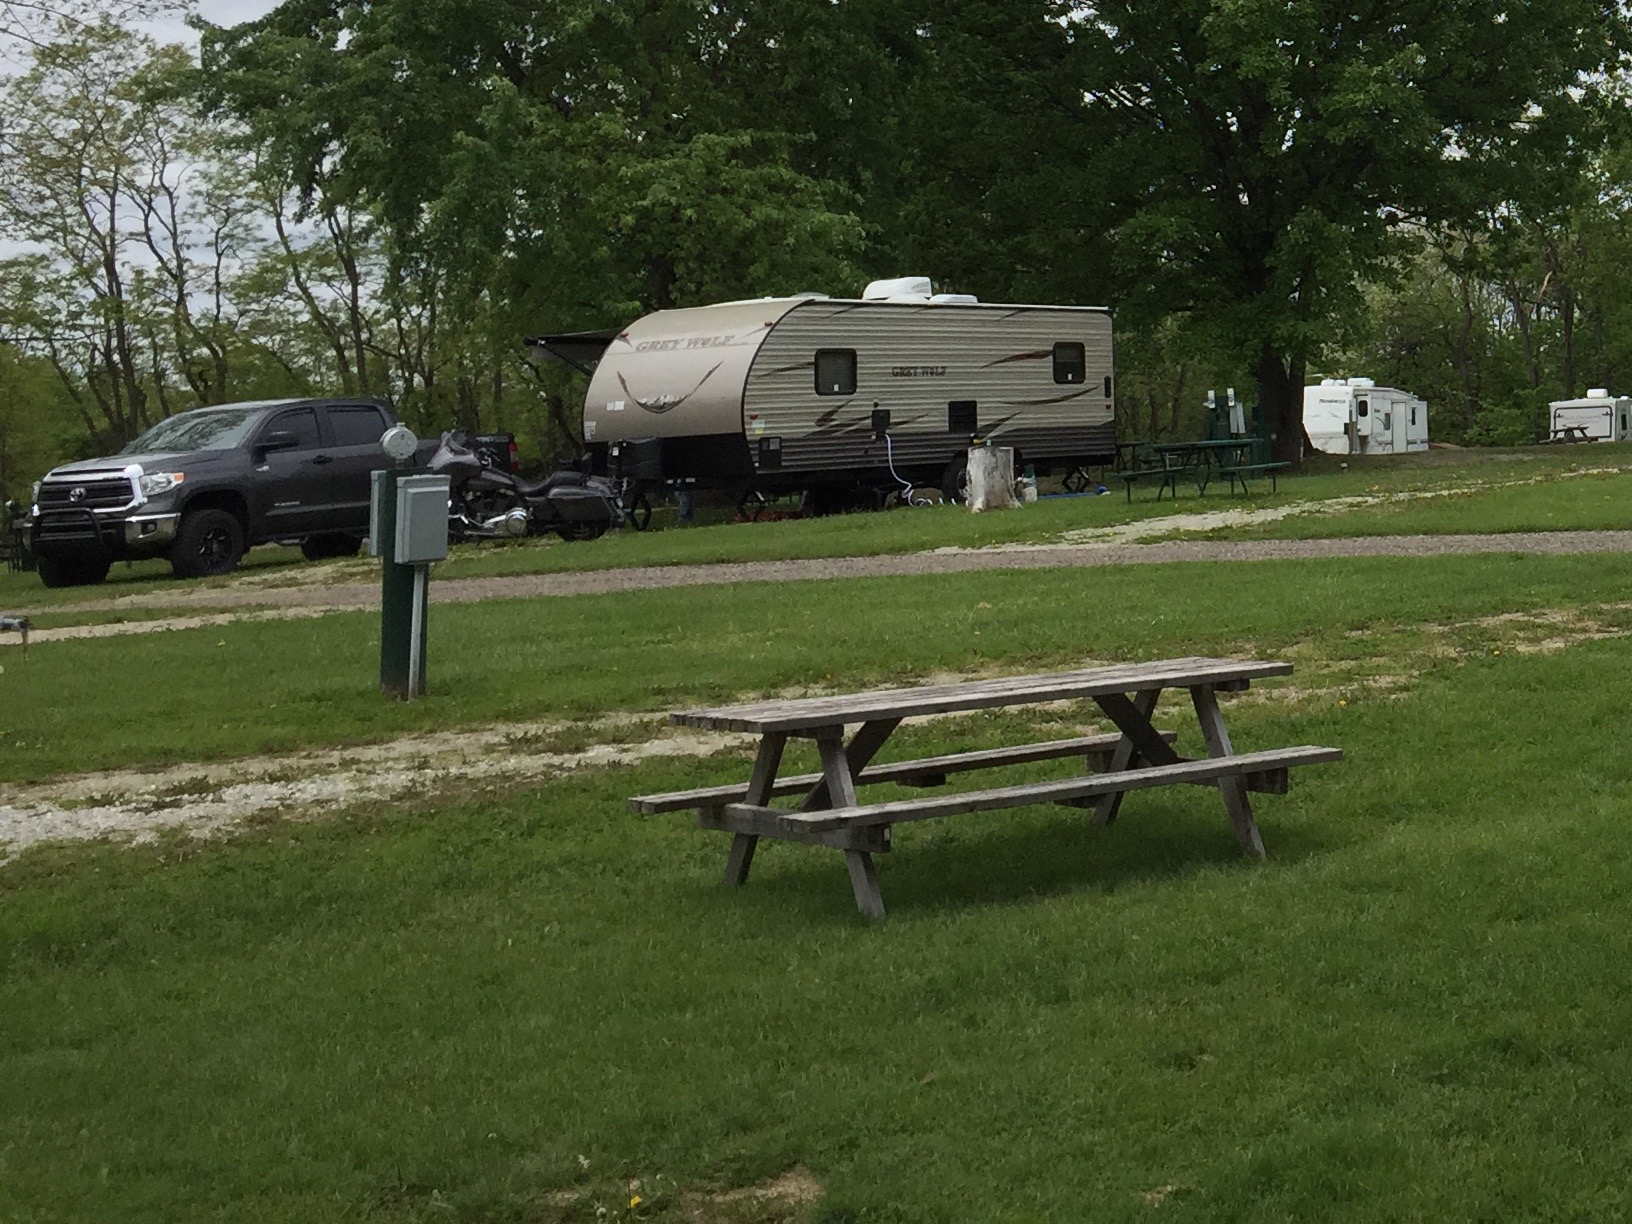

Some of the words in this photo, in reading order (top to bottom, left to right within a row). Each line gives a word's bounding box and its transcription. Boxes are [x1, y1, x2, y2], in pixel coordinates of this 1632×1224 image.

[635, 339, 683, 352] GREY
[686, 335, 735, 349] WOLF
[891, 366, 918, 377] GREY
